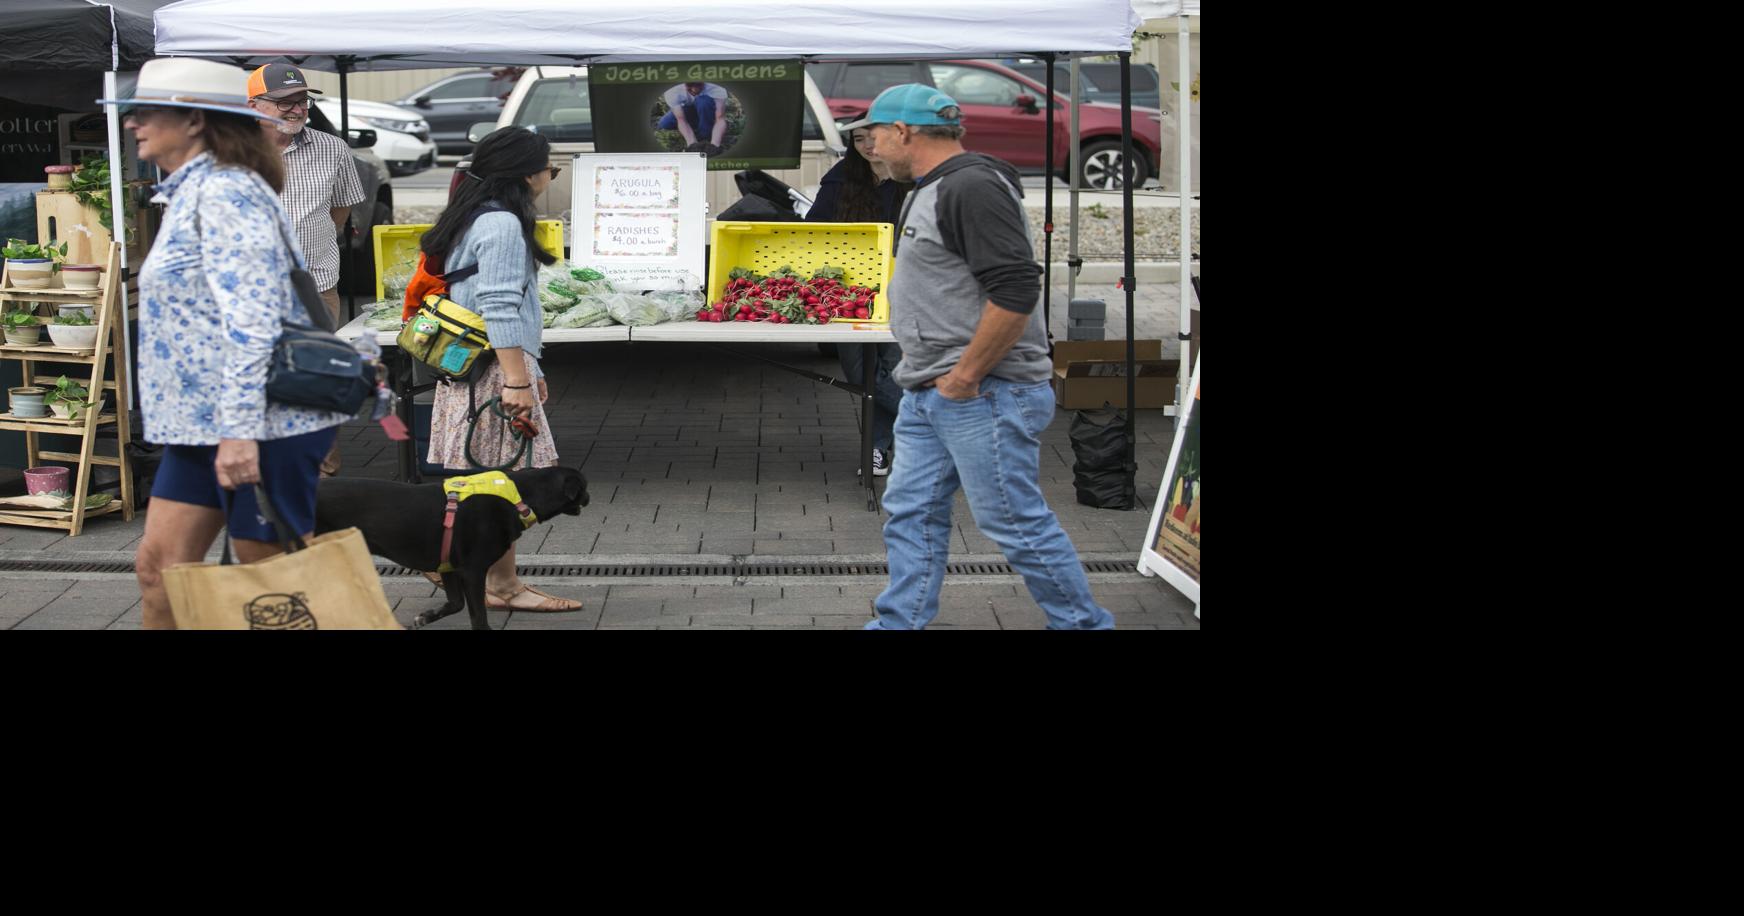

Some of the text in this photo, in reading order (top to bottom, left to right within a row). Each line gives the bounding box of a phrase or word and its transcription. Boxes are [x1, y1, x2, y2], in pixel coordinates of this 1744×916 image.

[605, 63, 787, 82] Josh's Gardens
[610, 178, 661, 188] ARUGULA
[607, 226, 660, 235] RADISHES
[612, 235, 638, 245] $4.00
